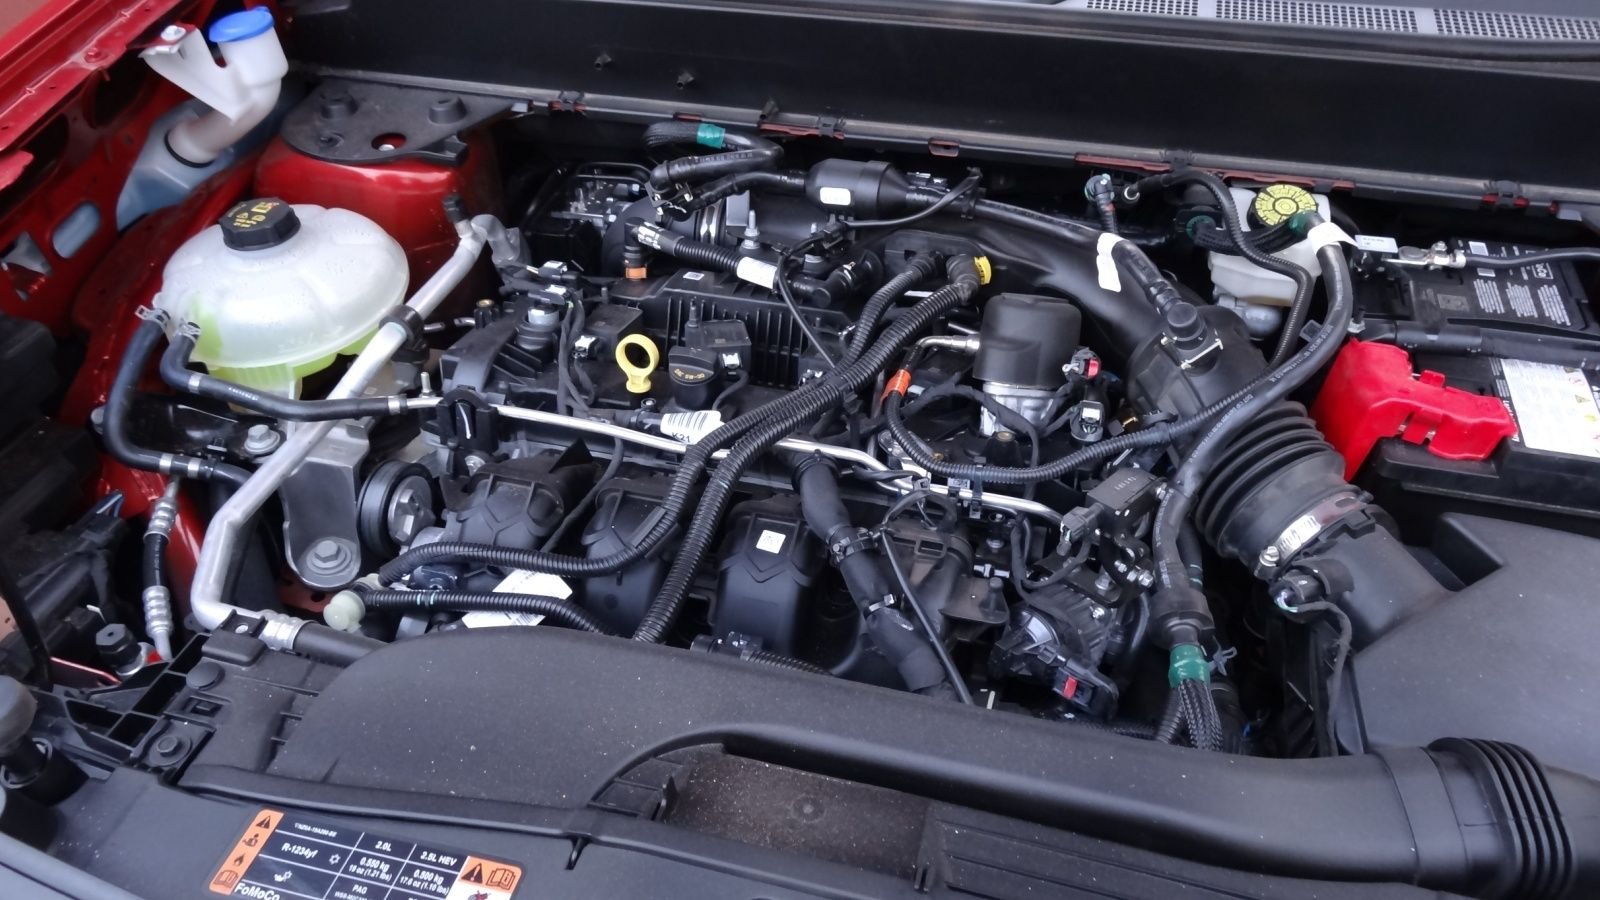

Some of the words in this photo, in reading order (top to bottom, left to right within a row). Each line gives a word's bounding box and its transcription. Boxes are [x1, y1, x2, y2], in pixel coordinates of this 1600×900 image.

[281, 842, 318, 859] R-1234yf
[375, 840, 391, 852] 2.0L
[420, 851, 437, 862] 2.5L
[438, 855, 457, 866] HEV
[379, 861, 390, 873] kg
[413, 869, 434, 881] 0.500
[434, 873, 444, 885] kg
[413, 880, 421, 888] oz
[234, 882, 280, 900] FoMoCo
